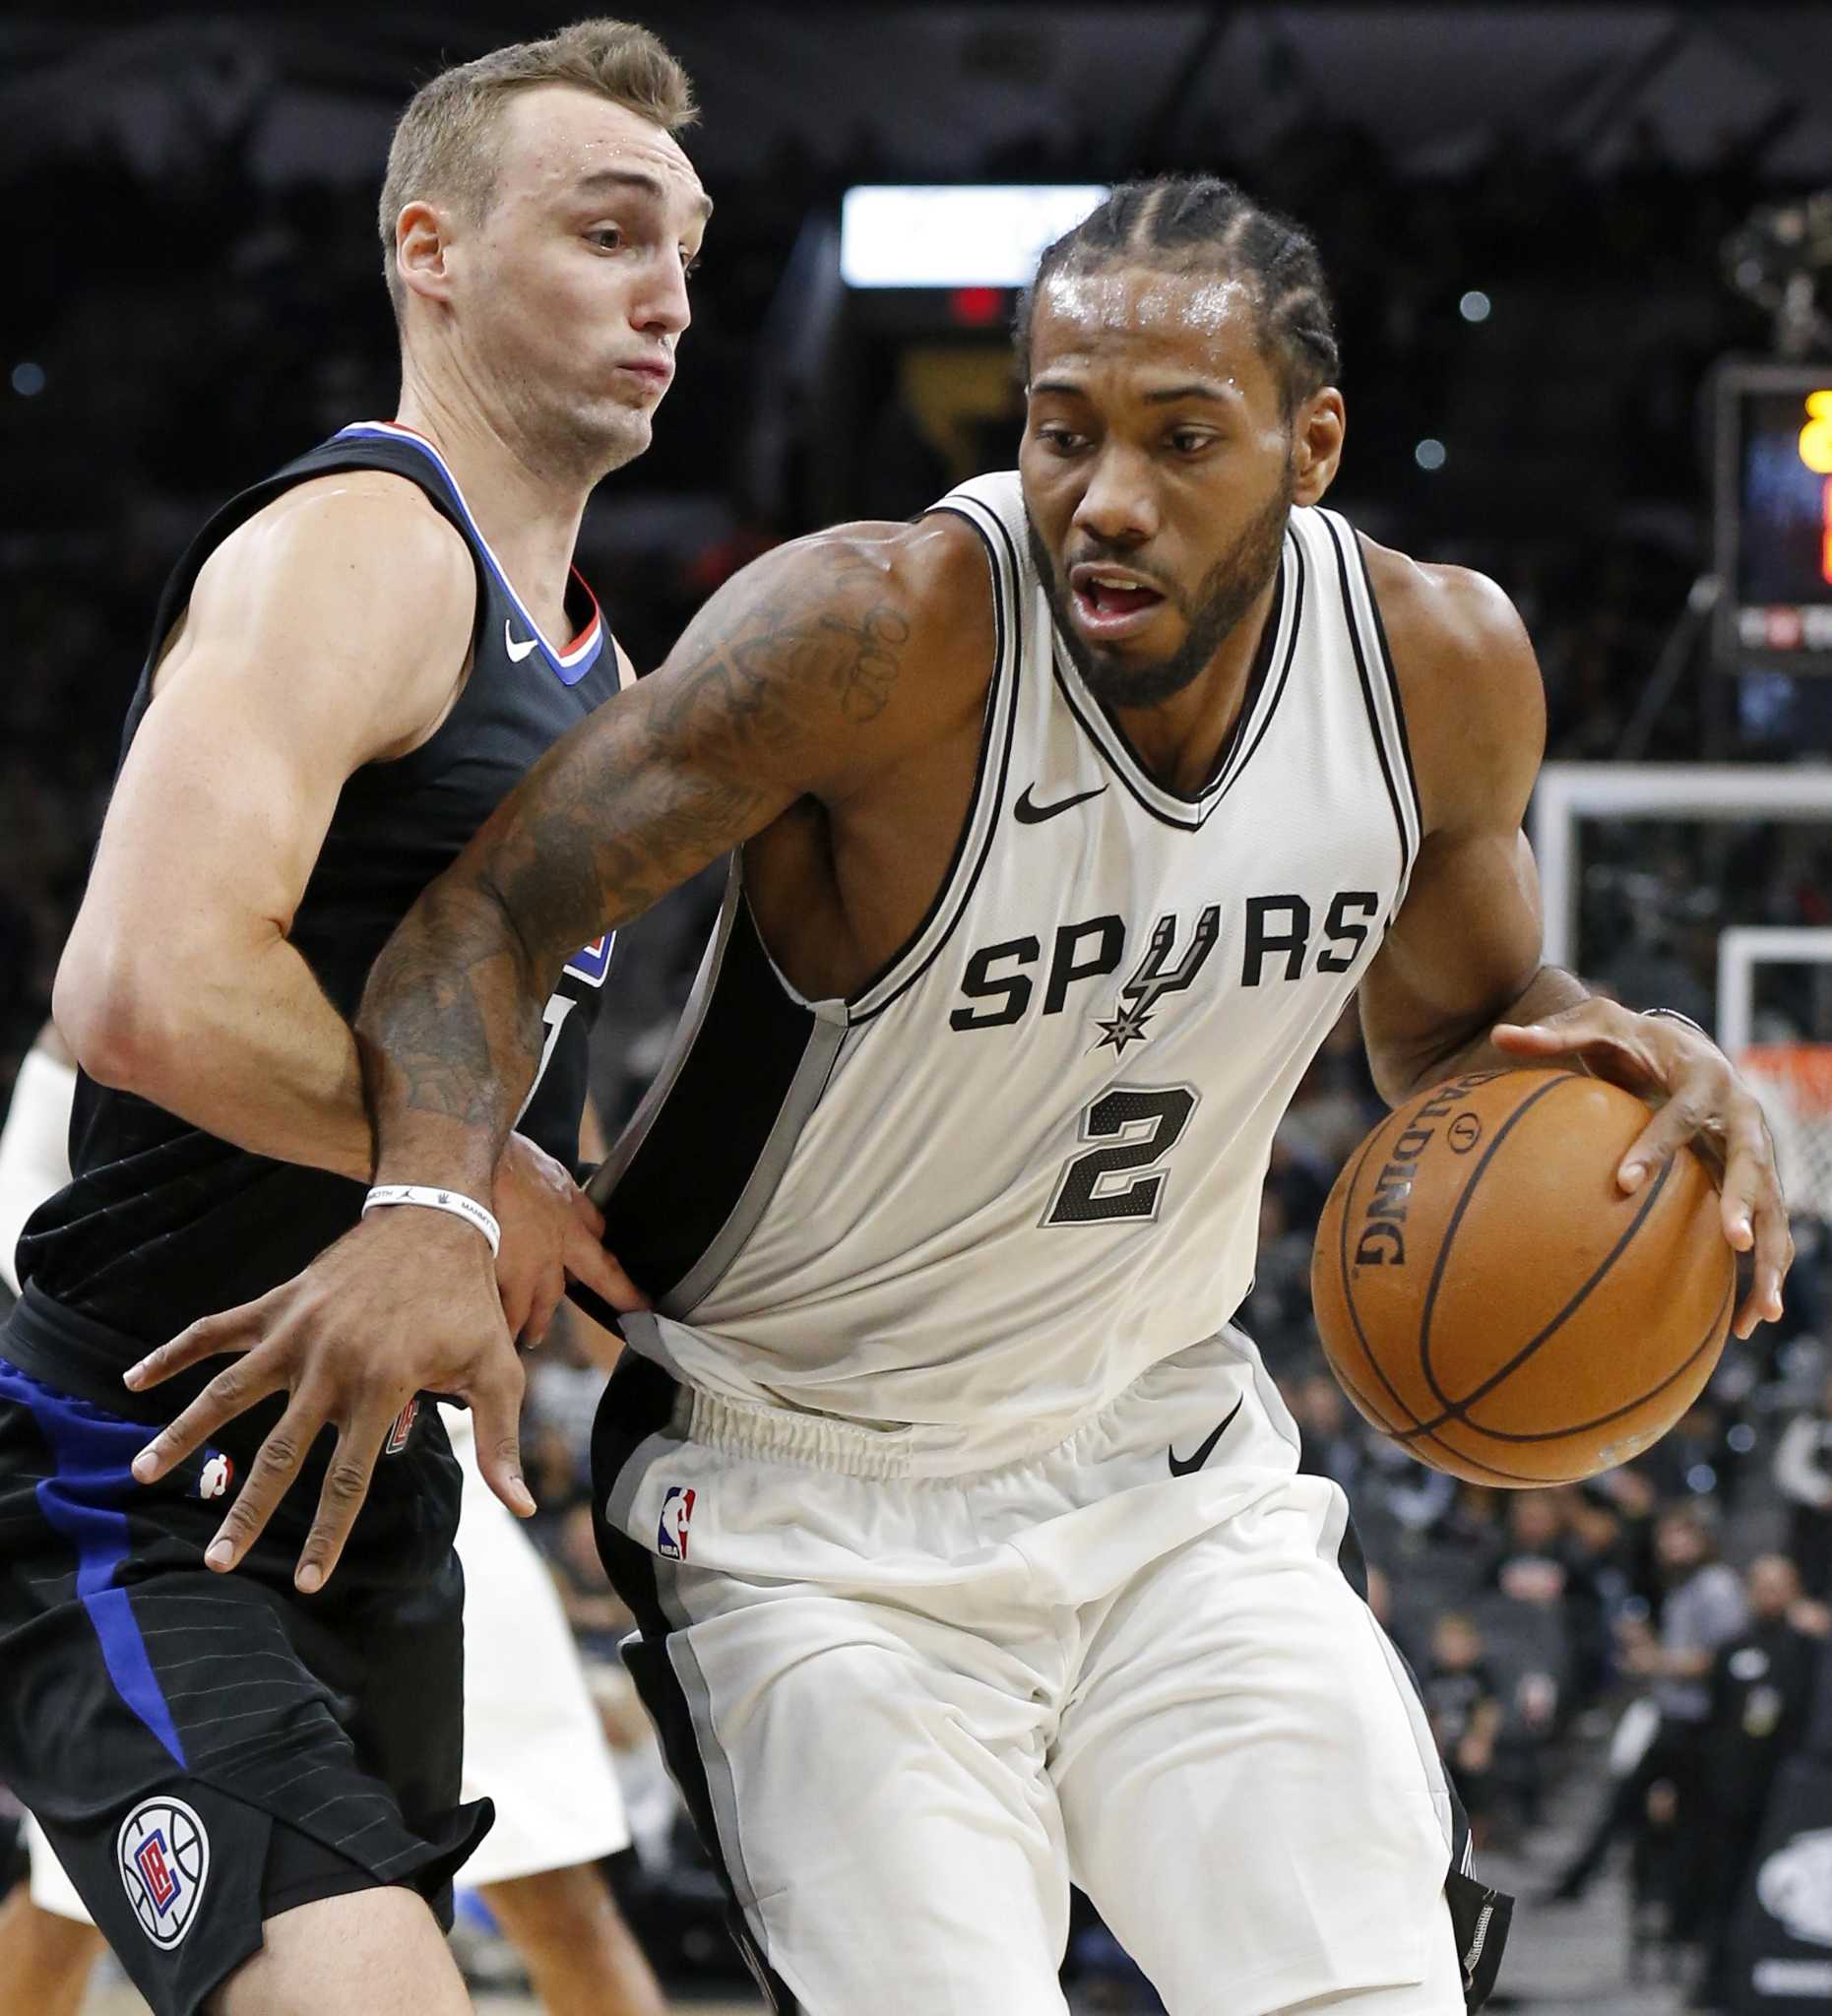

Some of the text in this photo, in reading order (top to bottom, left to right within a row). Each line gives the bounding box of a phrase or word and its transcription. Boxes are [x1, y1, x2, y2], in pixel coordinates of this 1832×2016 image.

[949, 891, 1379, 1058] SPURS
[1039, 1082, 1202, 1228] 2
[1355, 1068, 1500, 1267] PALDING
